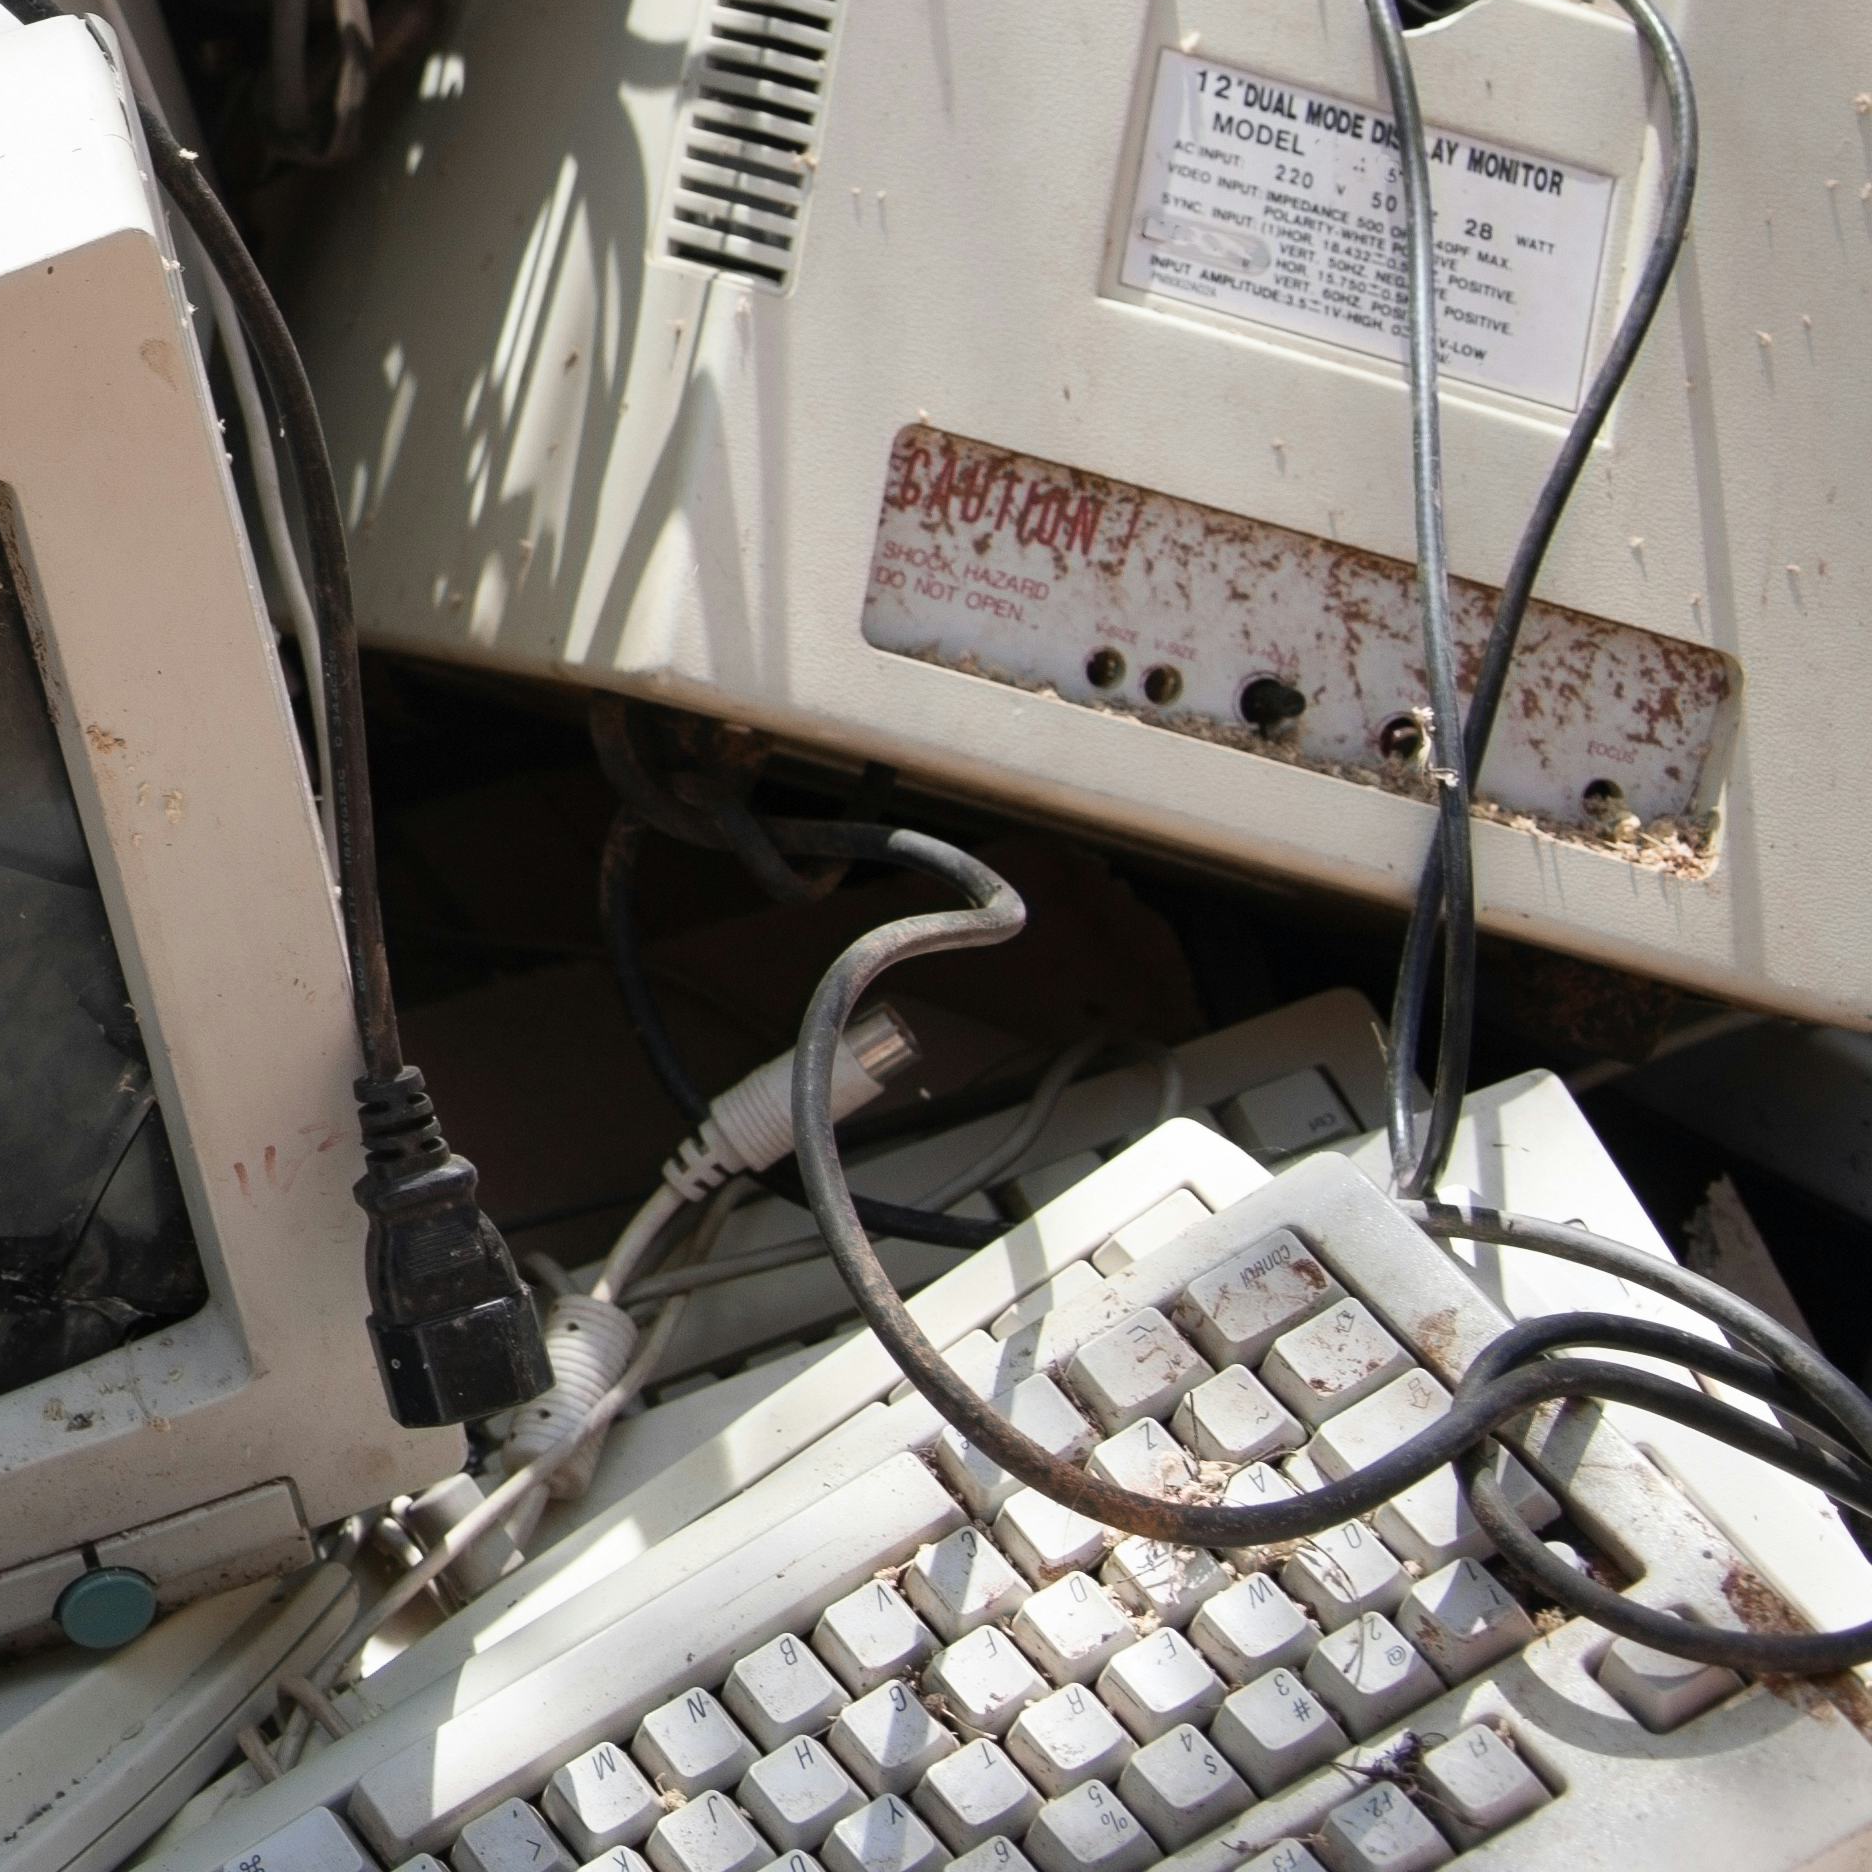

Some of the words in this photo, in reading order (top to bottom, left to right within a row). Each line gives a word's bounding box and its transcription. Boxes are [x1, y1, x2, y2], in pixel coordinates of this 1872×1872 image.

[1213, 112, 1305, 155] MODEL
[1306, 101, 1365, 139] MODE
[1371, 118, 1458, 165] DISAY
[1468, 147, 1564, 195] MONITOR
[1167, 161, 1211, 183] VIDEO
[1266, 190, 1350, 224] IMPEDANCE
[1174, 140, 1194, 153] AC
[1275, 164, 1314, 189] 220
[1371, 191, 1397, 213] 50
[1464, 219, 1493, 240] 28
[1516, 234, 1556, 256] WATT
[1150, 255, 1191, 275] INPUT
[898, 448, 1103, 557] CAUTION
[876, 565, 906, 591] DO
[914, 576, 957, 603] NOT
[883, 540, 954, 575] SHOCK
[964, 563, 1050, 601] HAZARD
[1586, 740, 1636, 764] FOCUS
[875, 1584, 894, 1612] V
[1246, 1581, 1276, 1609] W
[687, 1694, 711, 1723] N
[1065, 1689, 1085, 1715] R
[592, 1750, 615, 1780] M
[795, 1742, 815, 1769] H
